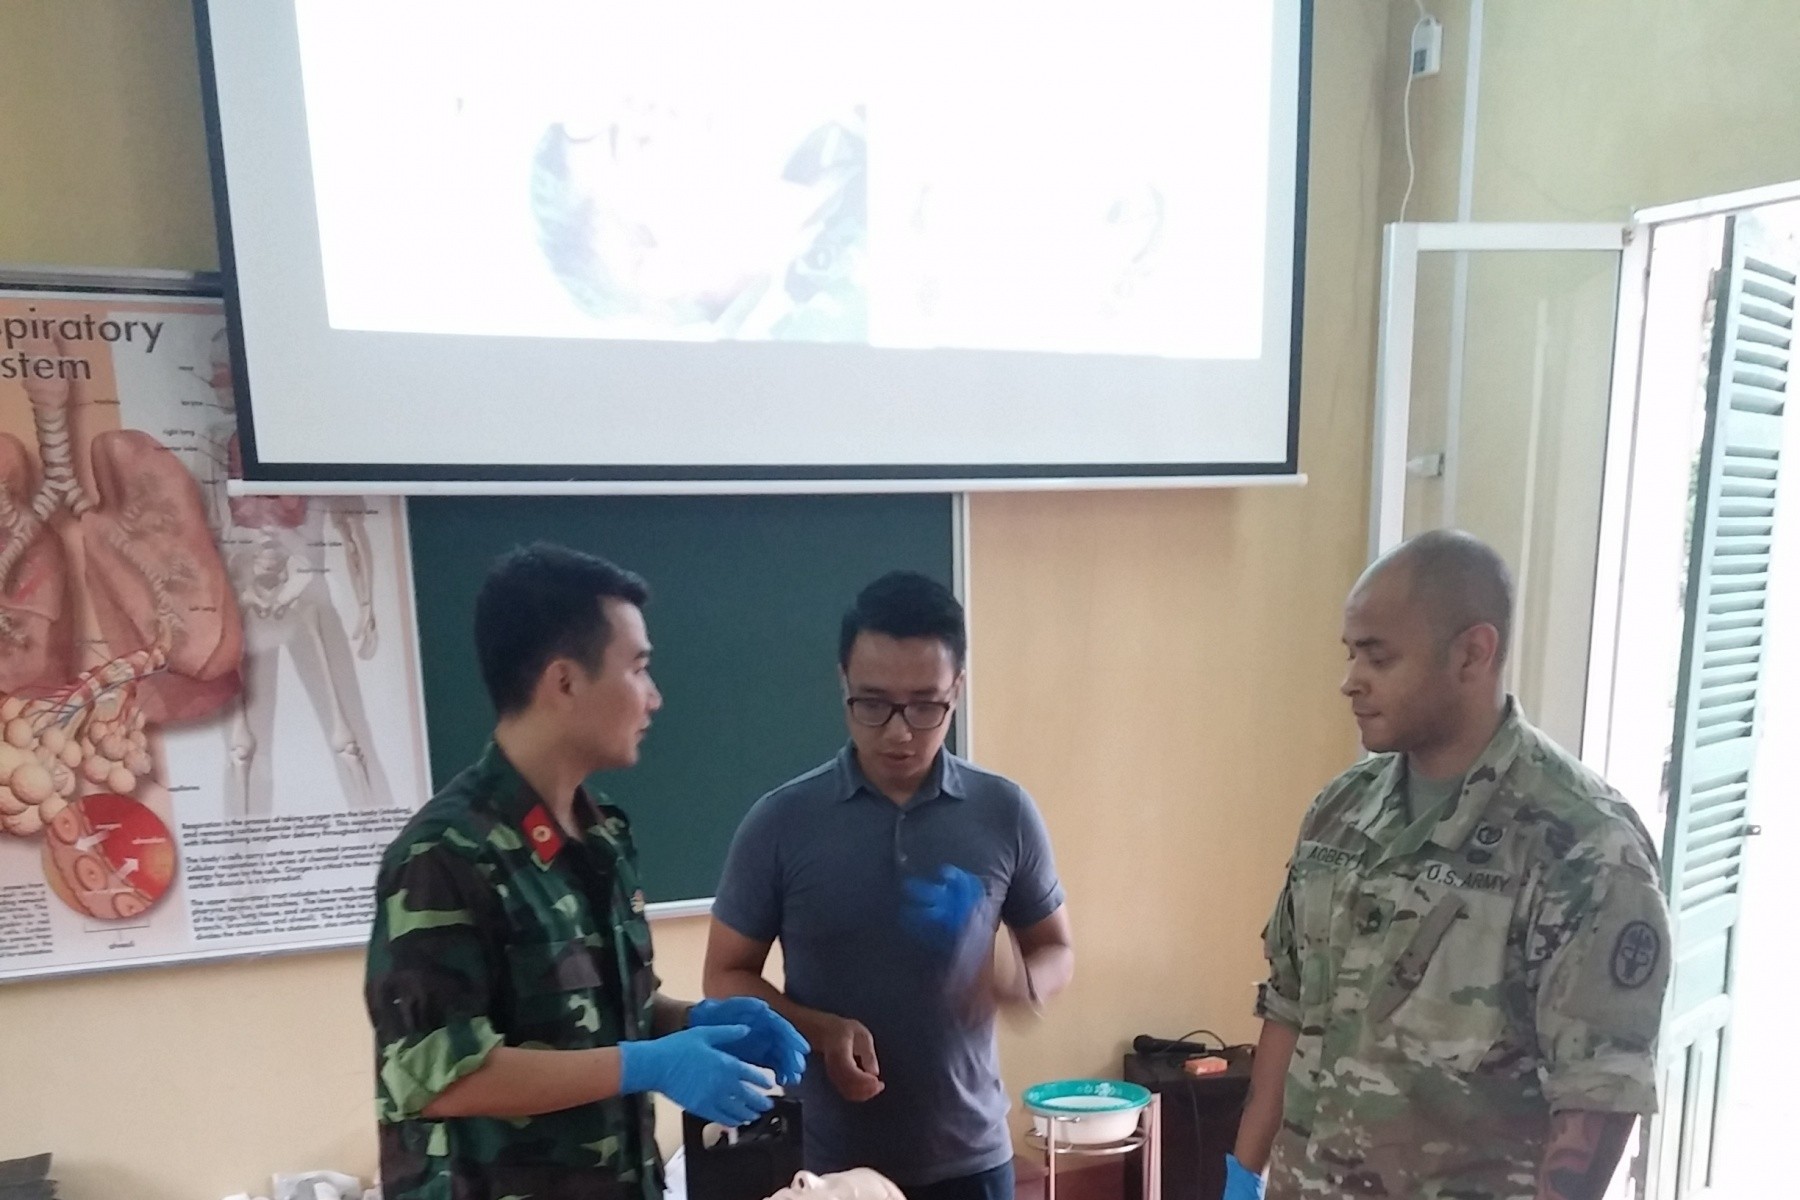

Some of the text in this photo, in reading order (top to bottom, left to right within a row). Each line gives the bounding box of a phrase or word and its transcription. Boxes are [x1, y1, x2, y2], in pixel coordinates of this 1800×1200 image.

[0, 308, 164, 353] piratory
[1, 352, 91, 380] stem
[1461, 871, 1512, 892] ARMY
